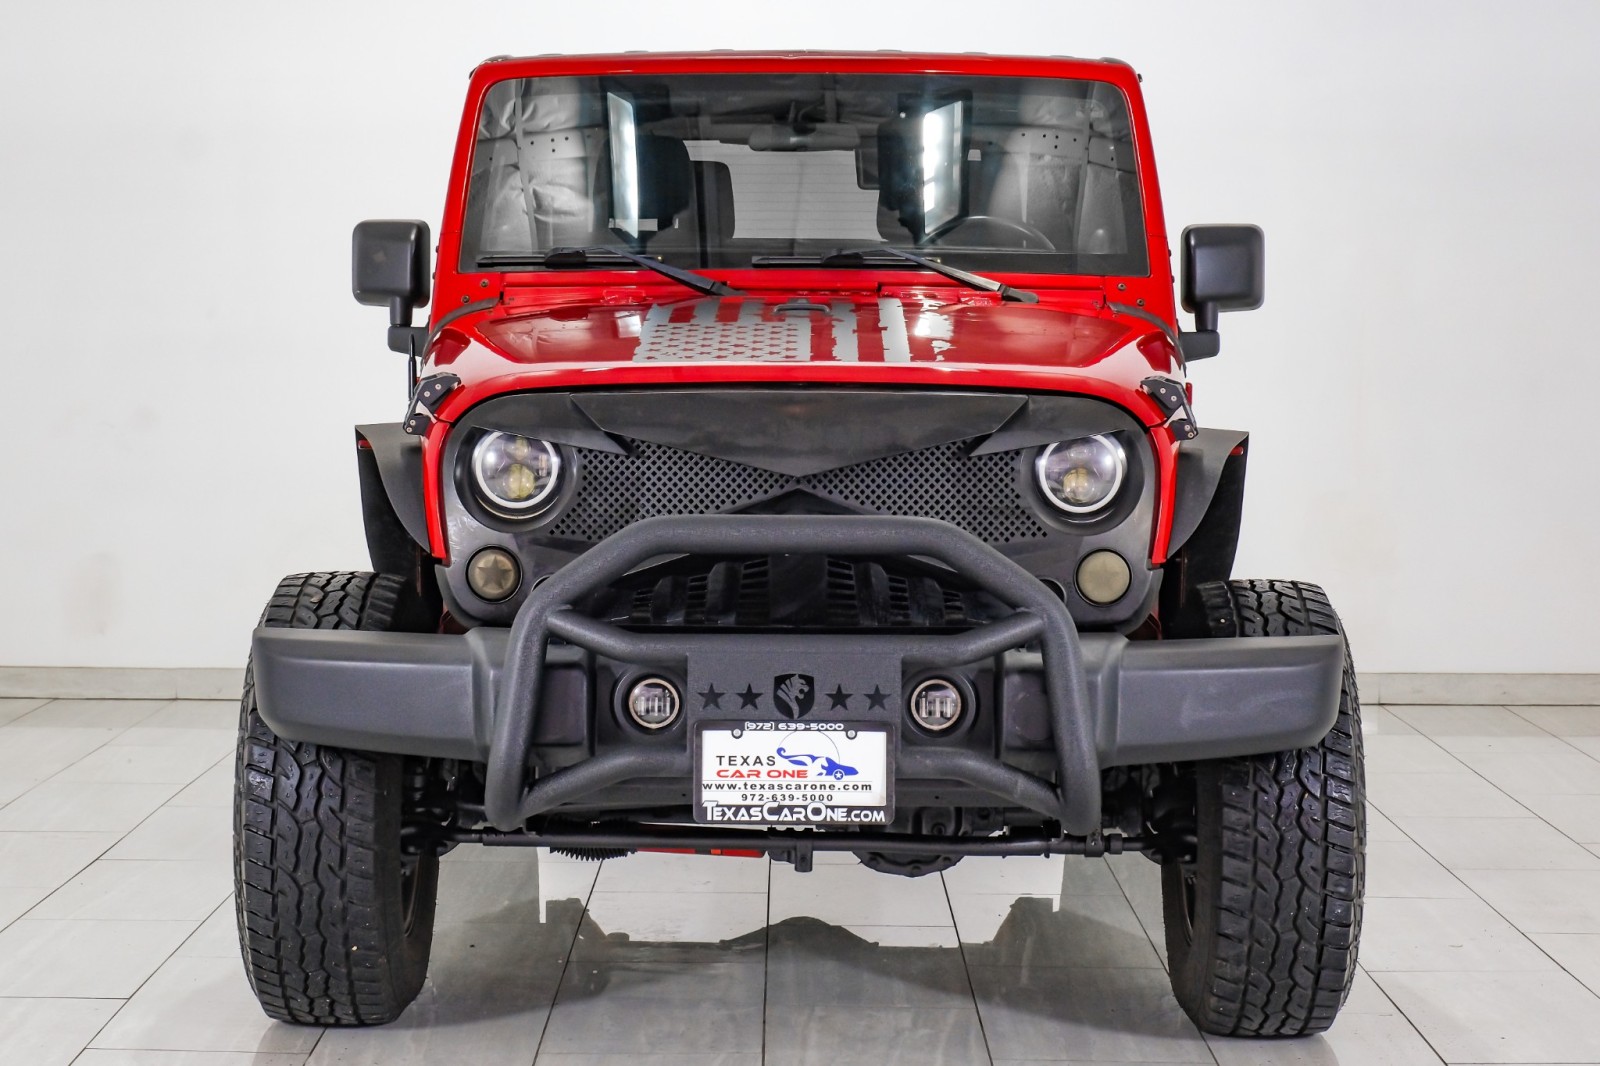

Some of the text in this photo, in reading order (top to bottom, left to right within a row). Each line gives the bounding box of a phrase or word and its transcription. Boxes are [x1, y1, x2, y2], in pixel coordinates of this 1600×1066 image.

[716, 755, 776, 766] TEXAS
[716, 769, 808, 778] CAR ONE
[702, 781, 872, 791] www.texascarone.com
[741, 793, 833, 802] 972-639-5000
